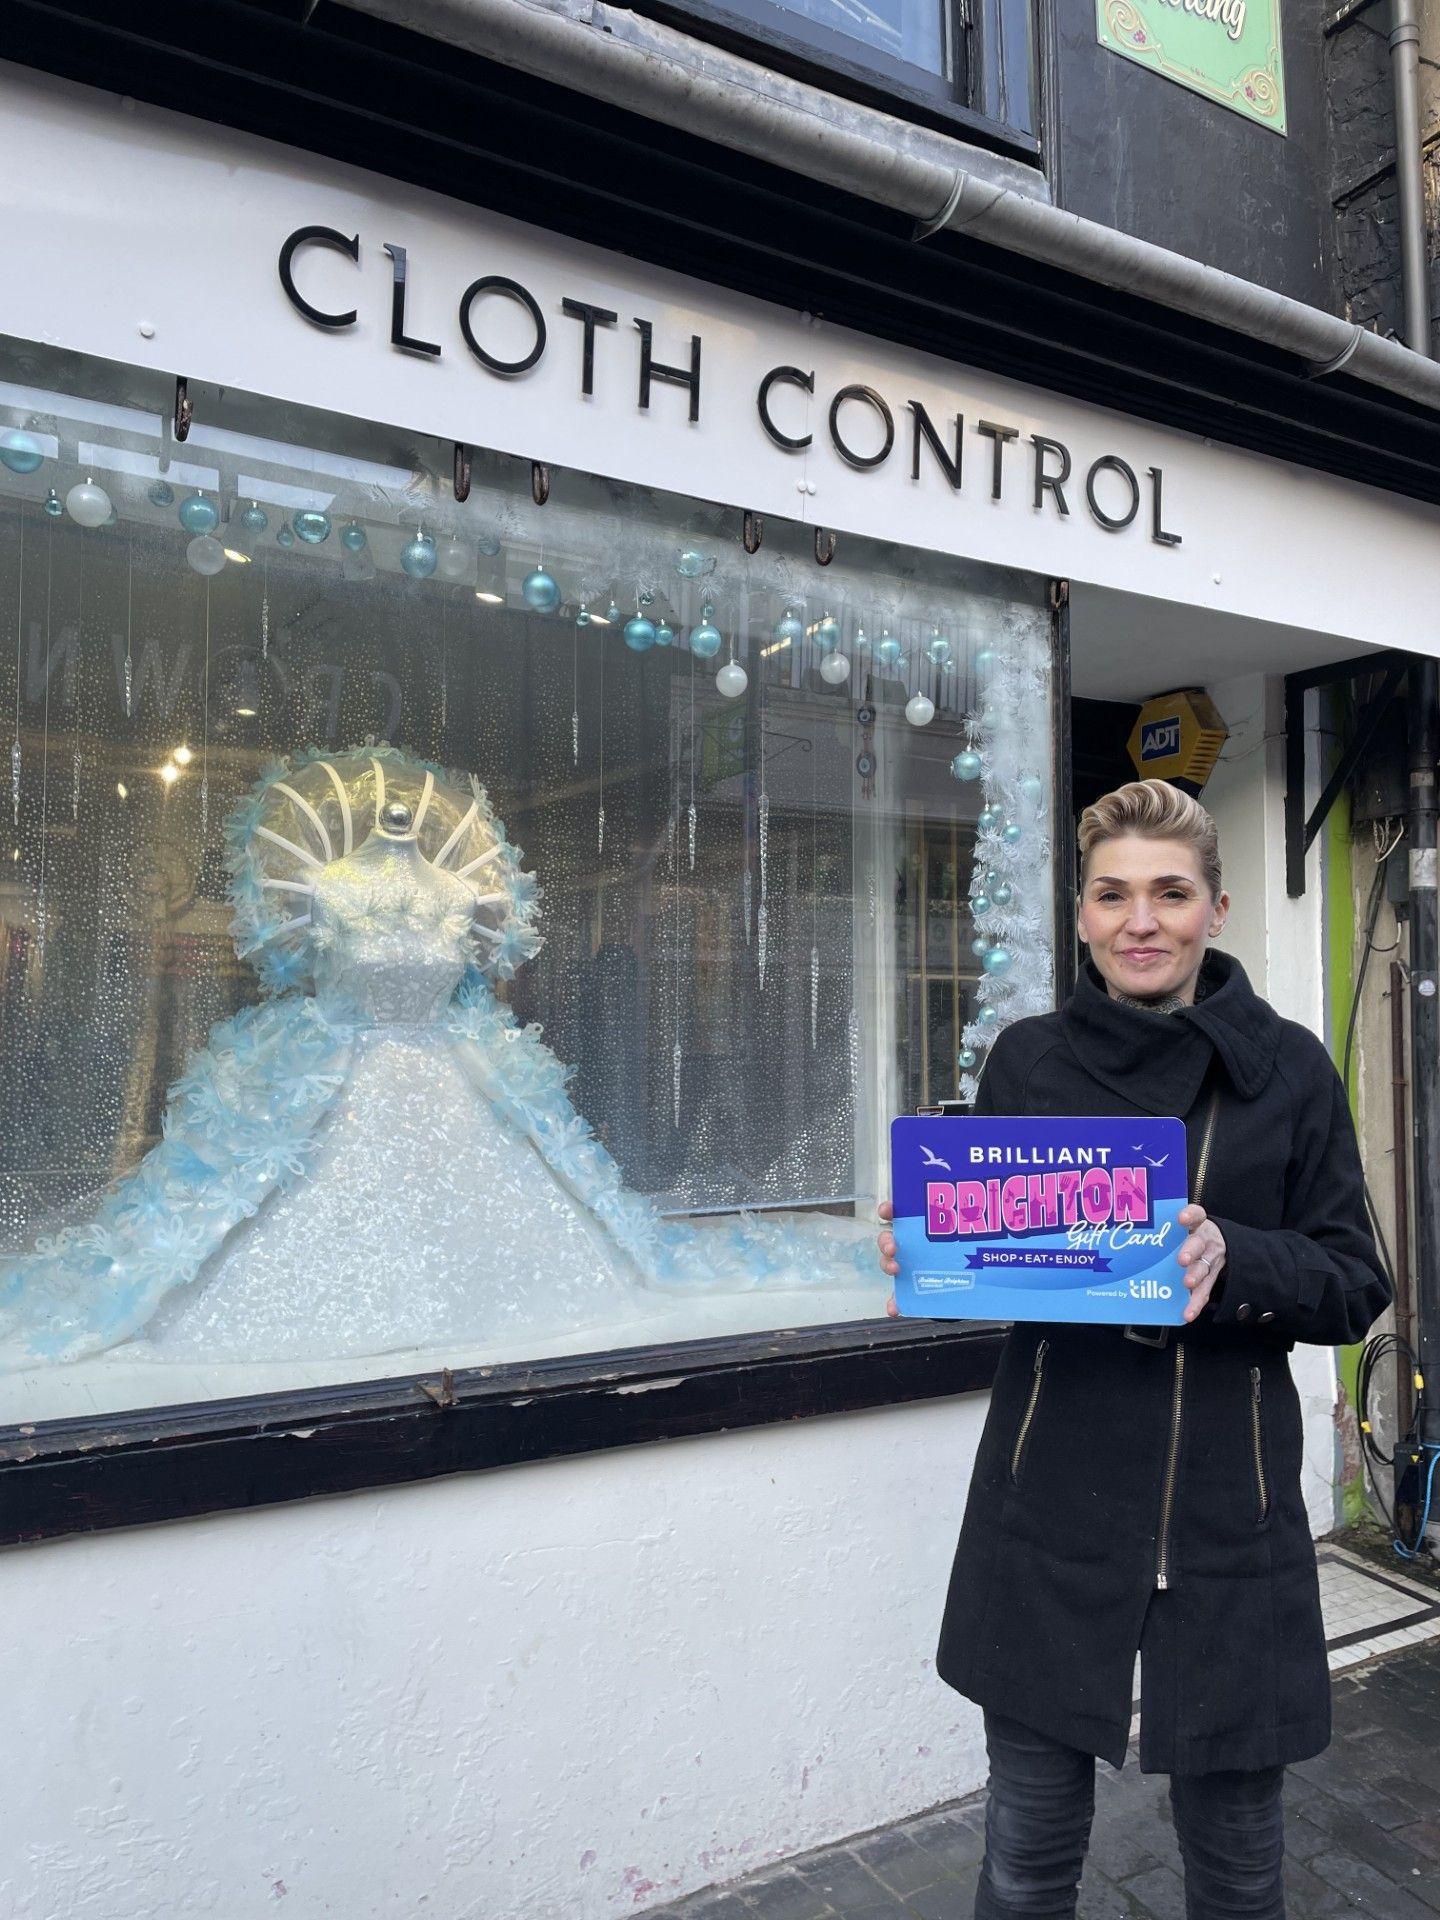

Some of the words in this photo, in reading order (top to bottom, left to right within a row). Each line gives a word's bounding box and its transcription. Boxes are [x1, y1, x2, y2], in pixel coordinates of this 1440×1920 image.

[279, 225, 702, 422] CLOTH
[756, 365, 1182, 545] CONTROL
[1141, 724, 1180, 754] ADT
[969, 1147, 1111, 1164] BRILLIANT
[926, 1166, 1150, 1237] BRIGHTON
[1066, 1219, 1109, 1250] Gift
[1110, 1221, 1171, 1250] Card
[982, 1253, 1017, 1263] SHOP
[1025, 1254, 1049, 1263] EAT
[1055, 1255, 1096, 1265] ENJOY
[1087, 1289, 1118, 1298] Powered
[1119, 1290, 1128, 1299] by
[1129, 1280, 1172, 1299] tillo
